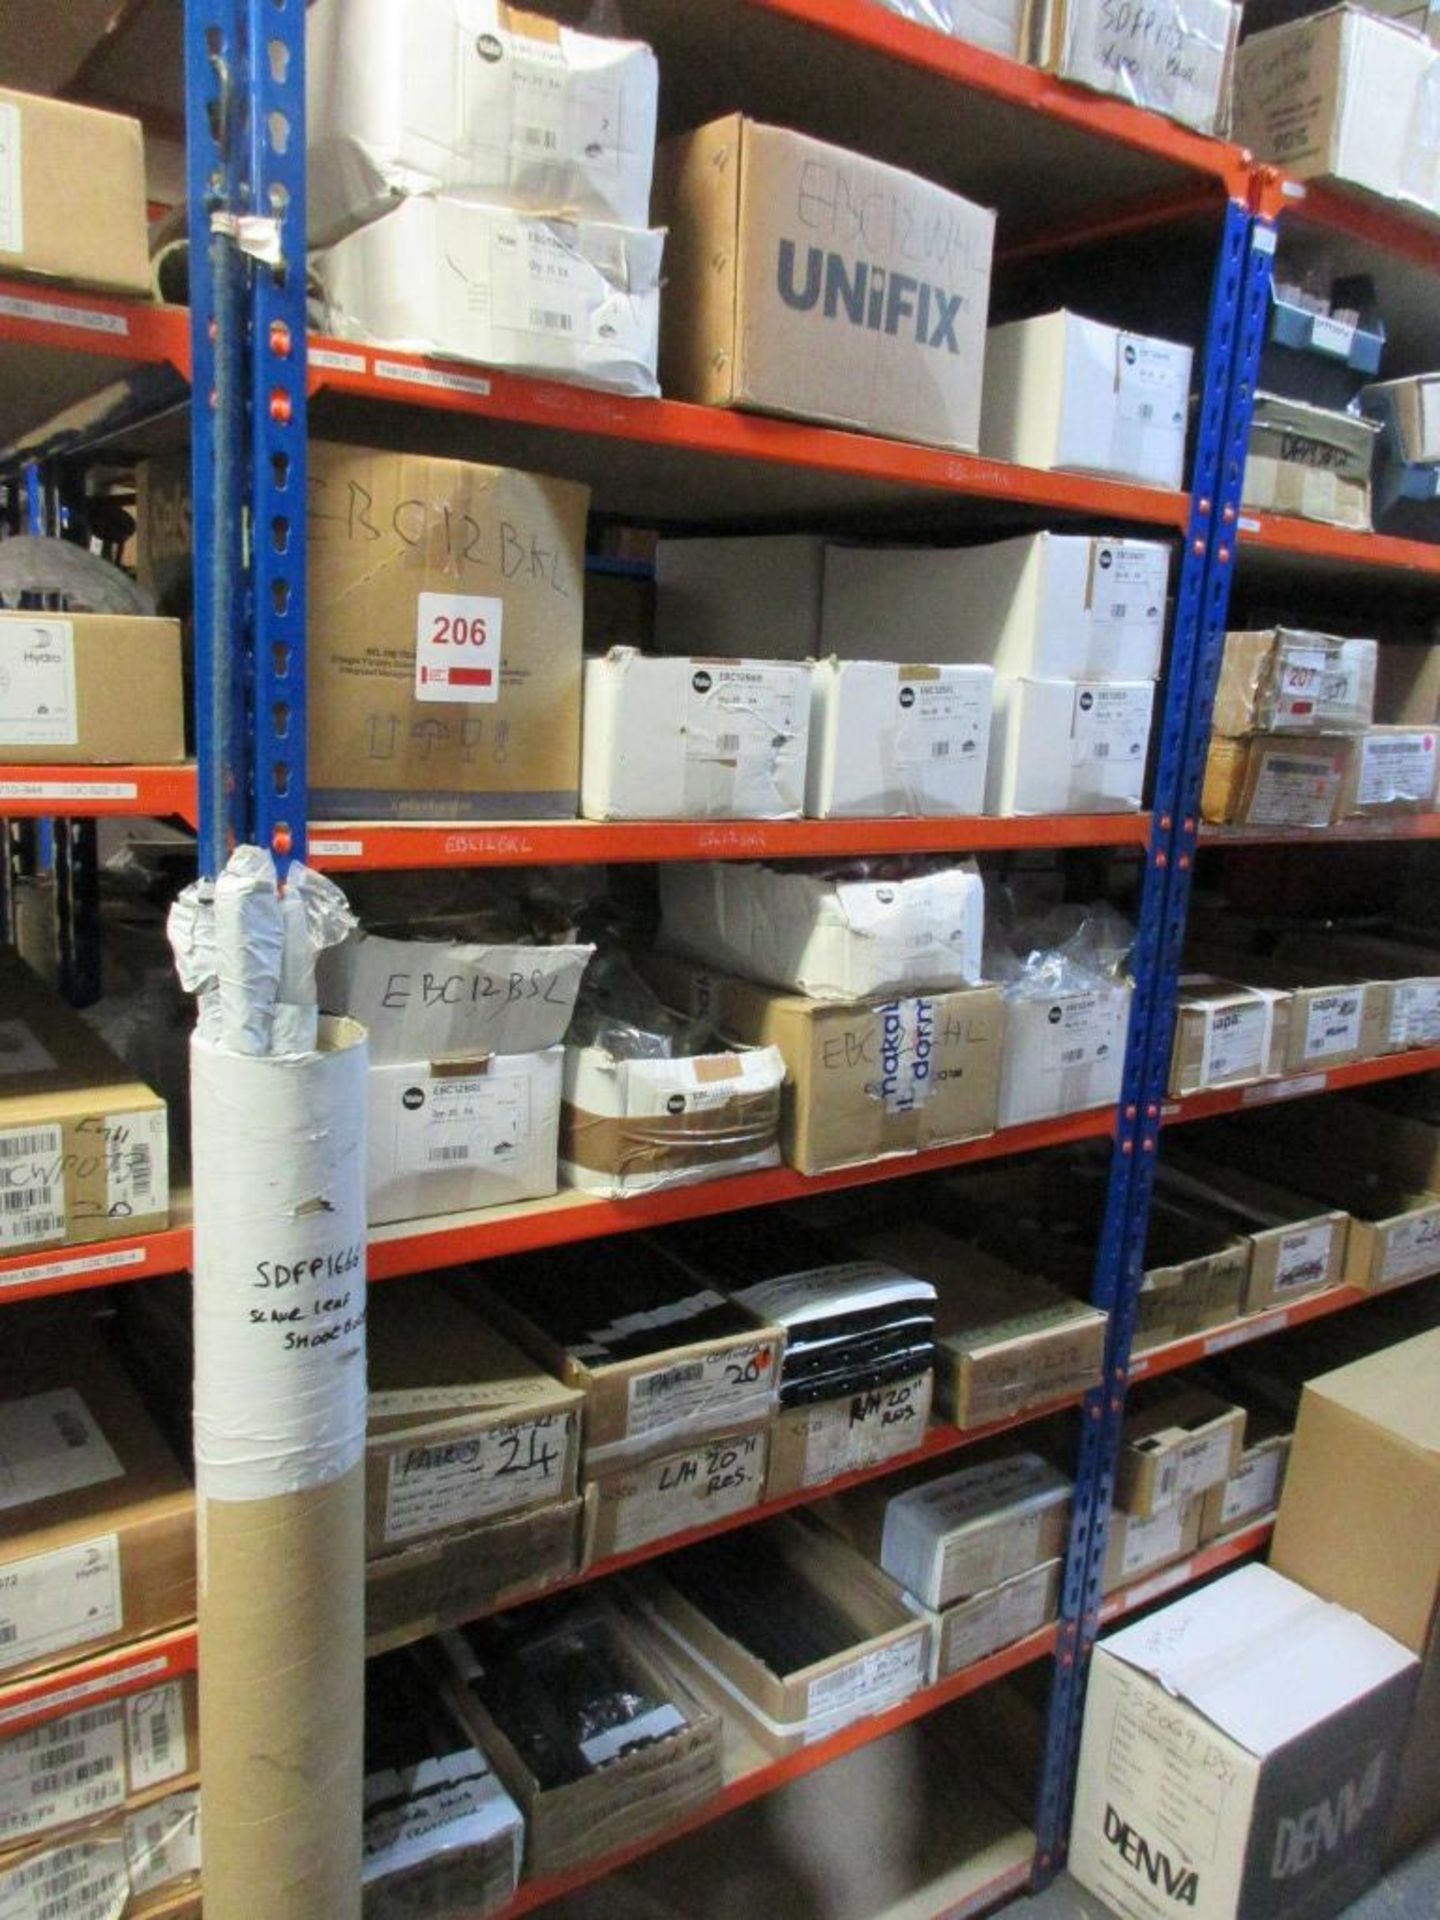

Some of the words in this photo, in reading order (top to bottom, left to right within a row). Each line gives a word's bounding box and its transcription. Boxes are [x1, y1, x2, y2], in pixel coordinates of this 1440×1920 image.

[432, 616, 487, 647] 206
[495, 1430, 559, 1476] 24
[1104, 1802, 1200, 1906] DENVA
